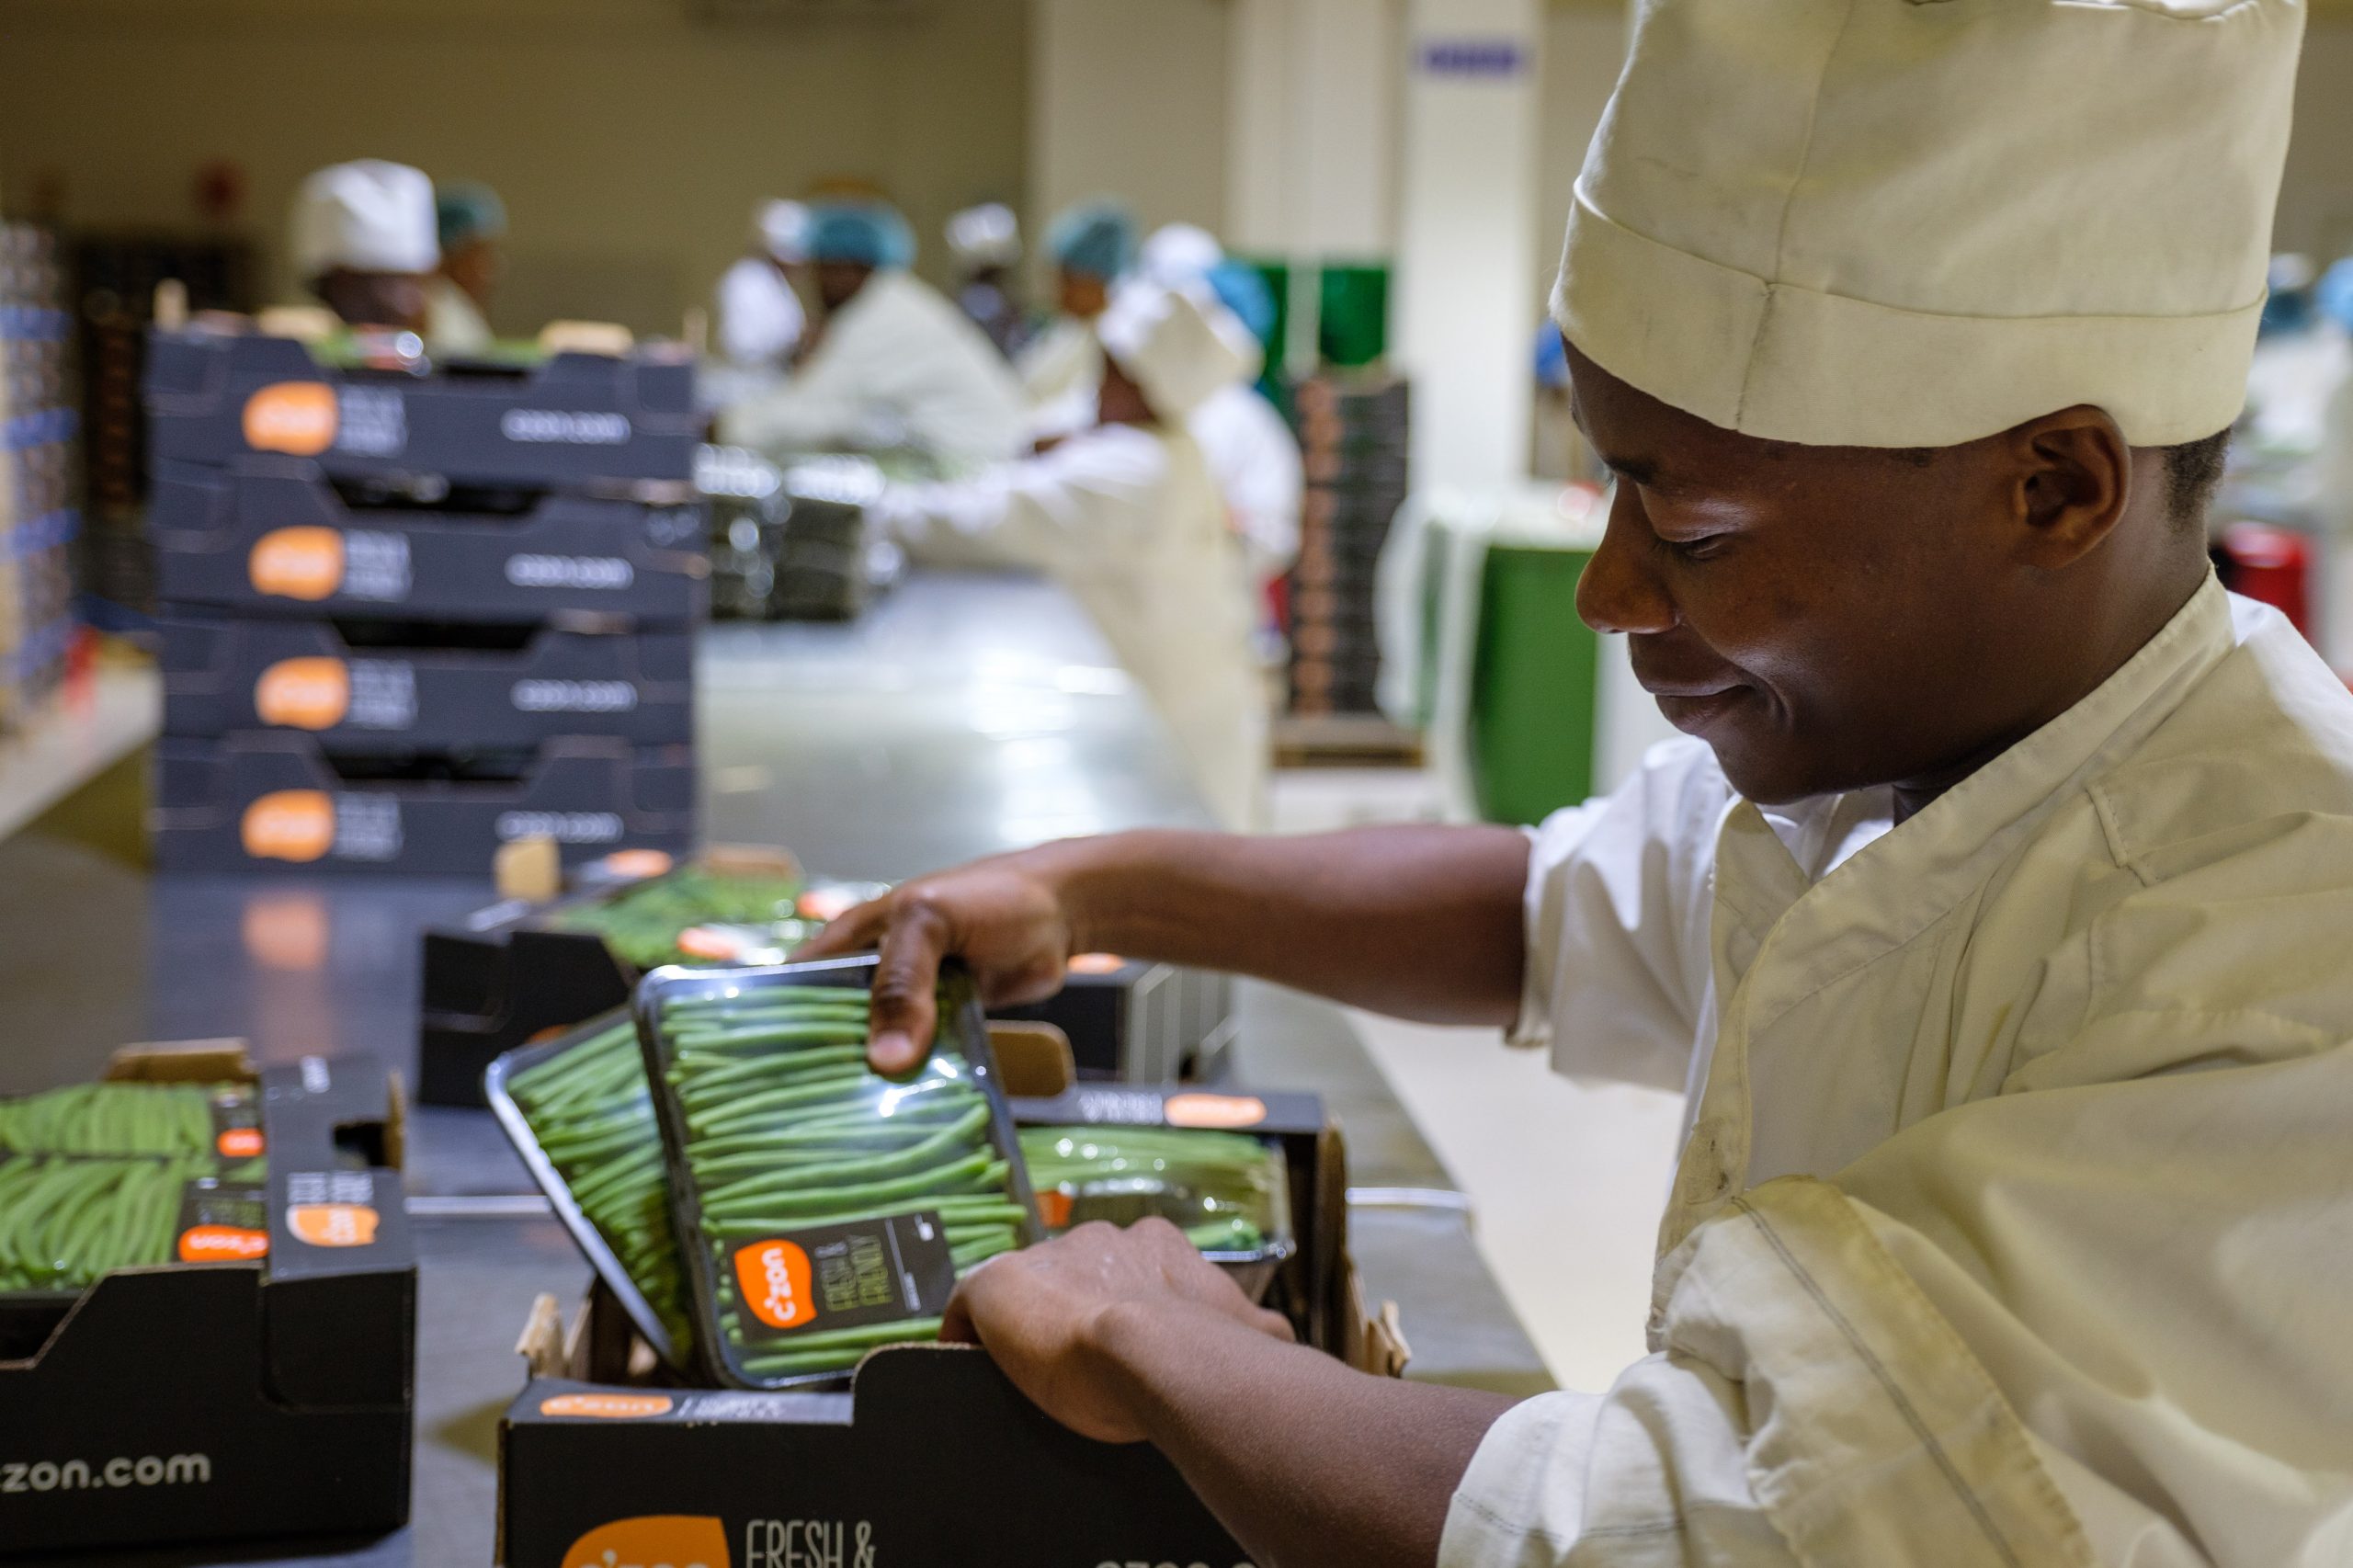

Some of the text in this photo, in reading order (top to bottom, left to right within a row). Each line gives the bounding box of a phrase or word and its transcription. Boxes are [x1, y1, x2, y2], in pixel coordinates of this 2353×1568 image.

[761, 1246, 797, 1322] c'zon
[745, 1518, 845, 1568] FRESH
[852, 1519, 877, 1568] &
